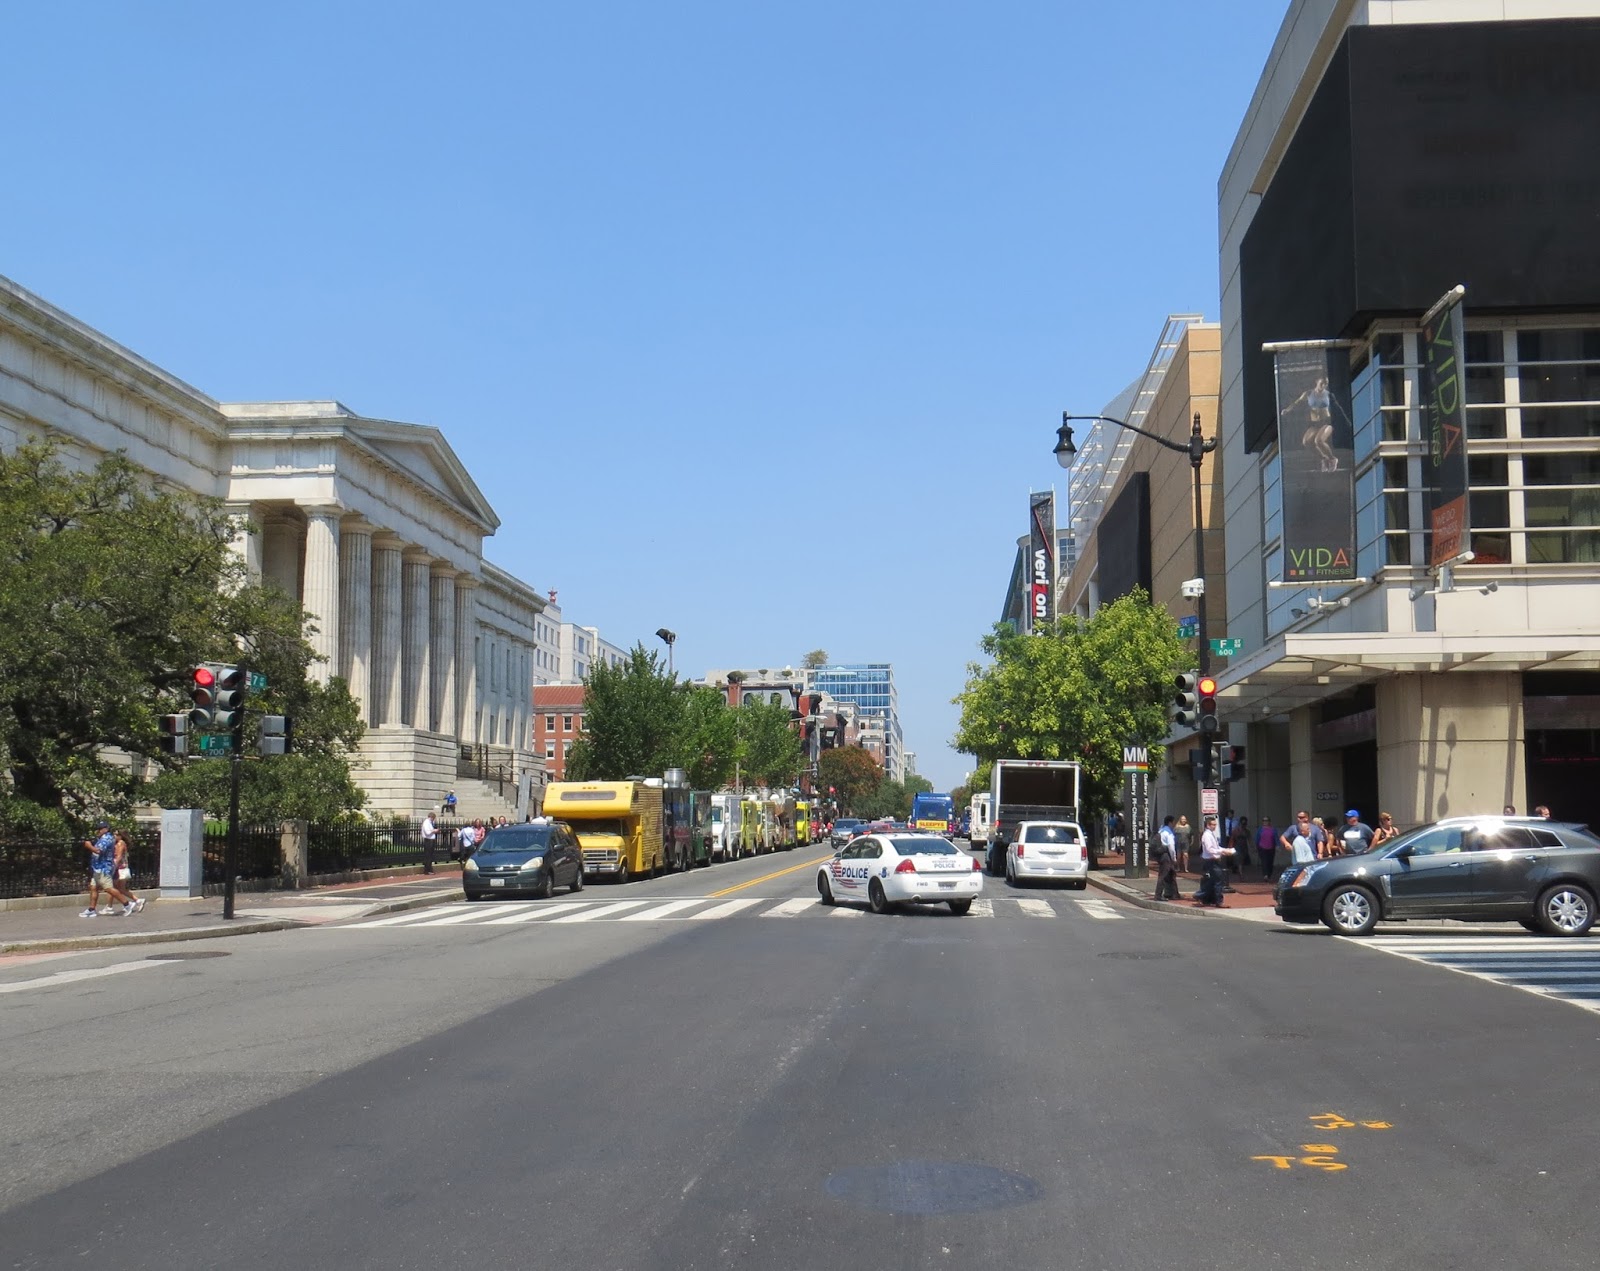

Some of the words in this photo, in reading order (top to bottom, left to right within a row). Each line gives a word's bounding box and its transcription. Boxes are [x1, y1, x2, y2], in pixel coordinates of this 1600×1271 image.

[1433, 311, 1462, 459] VIDA
[1290, 549, 1349, 567] VIDA
[1034, 549, 1049, 618] verizon
[1179, 628, 1185, 637] 7
[1220, 640, 1227, 648] F
[253, 675, 258, 685] 7
[209, 737, 216, 747] F
[209, 748, 225, 756] 700
[841, 867, 869, 879] POLICE
